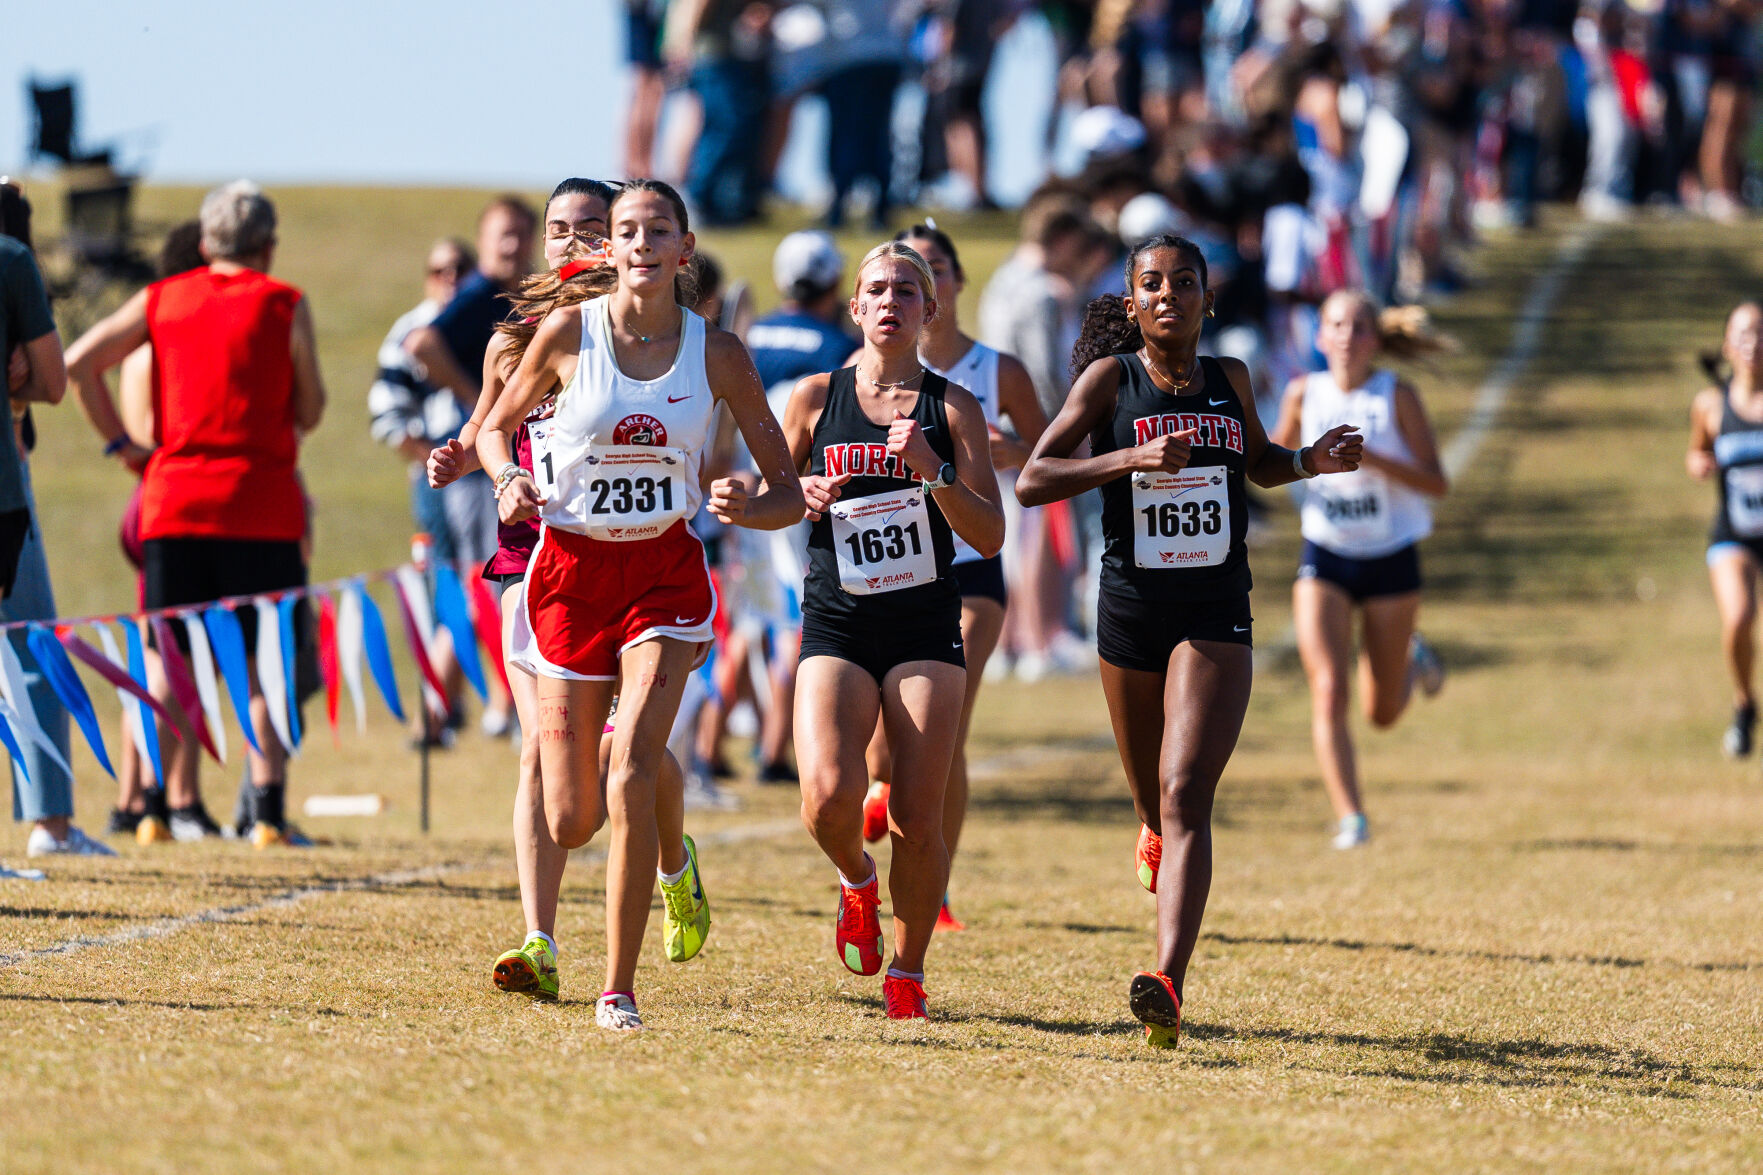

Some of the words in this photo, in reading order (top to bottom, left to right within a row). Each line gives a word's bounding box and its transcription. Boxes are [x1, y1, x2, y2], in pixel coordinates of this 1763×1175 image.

[618, 415, 665, 437] ARCHER
[1134, 412, 1244, 455] NORTH
[824, 443, 922, 482] NORT
[590, 477, 673, 514] 2331
[626, 526, 658, 535] ATLANTA
[1141, 500, 1222, 537] 1633
[845, 521, 922, 566] 1631
[1176, 551, 1208, 560] ATLANTA
[883, 571, 914, 583] ATLANTA
